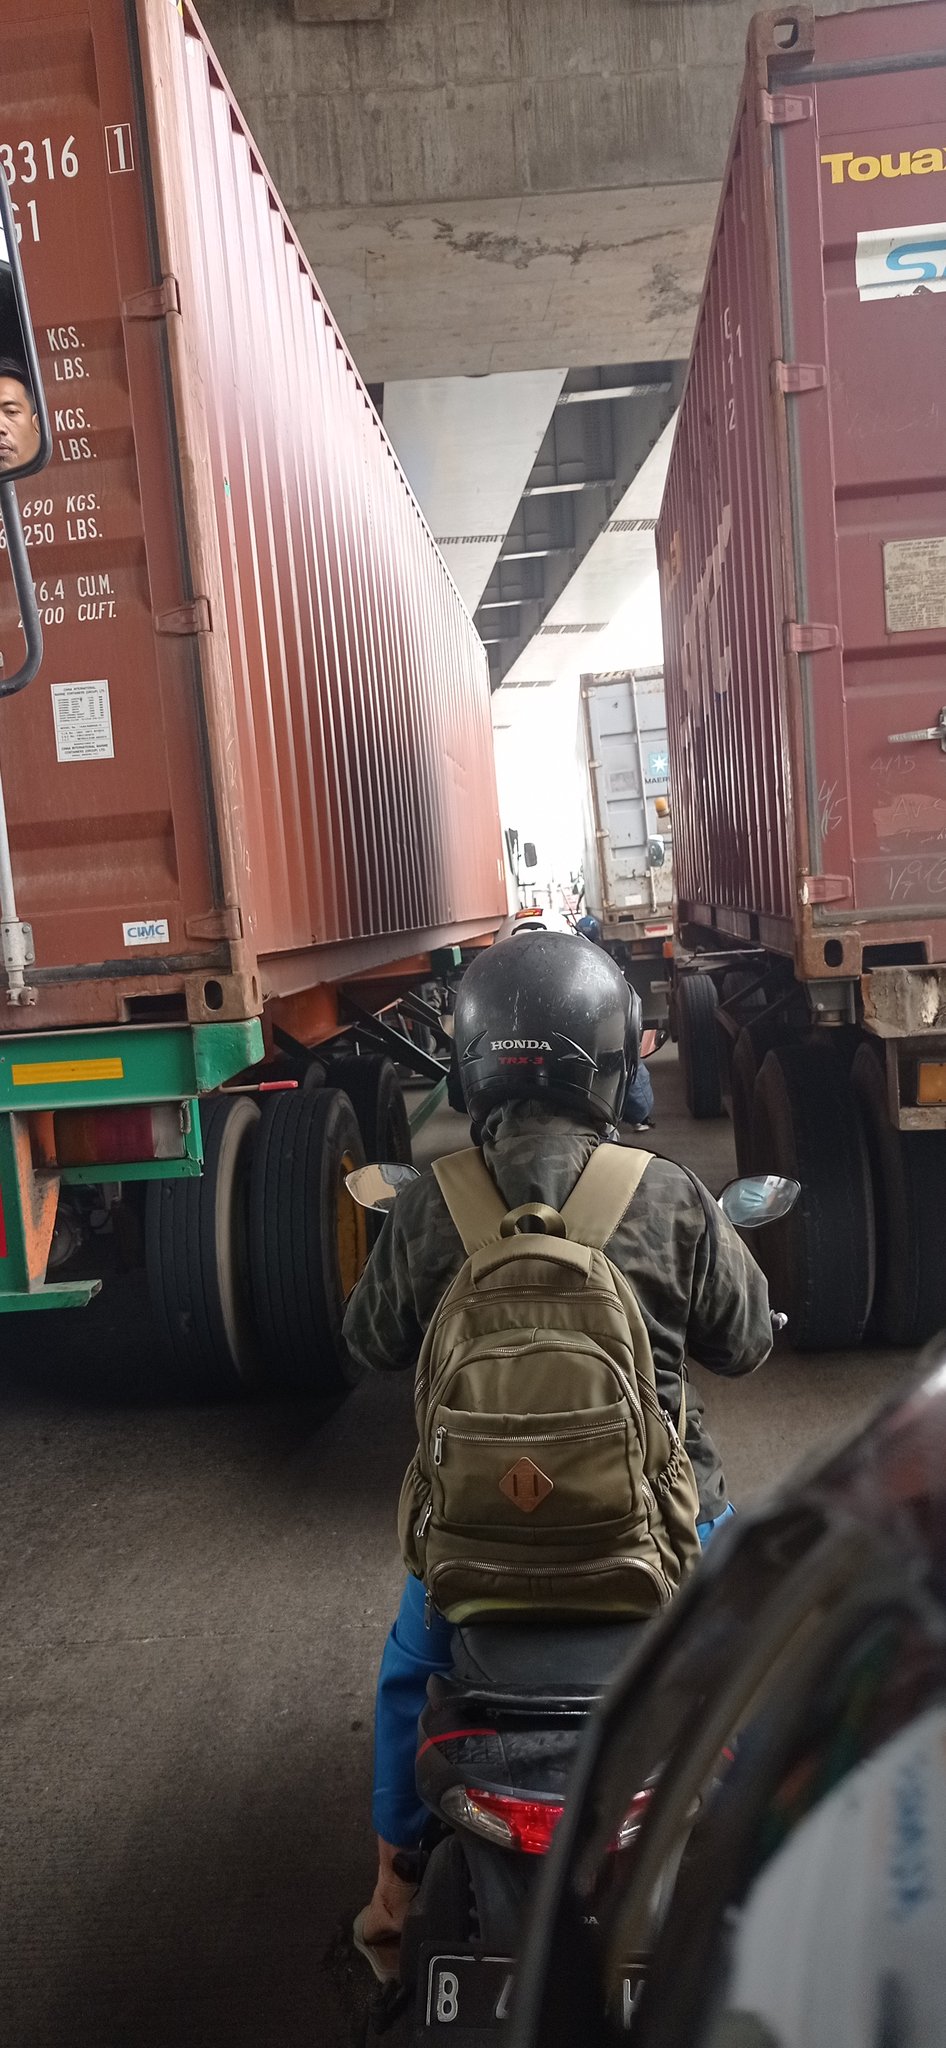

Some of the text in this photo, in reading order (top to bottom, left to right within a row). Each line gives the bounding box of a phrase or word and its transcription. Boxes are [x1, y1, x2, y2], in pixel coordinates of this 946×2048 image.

[113, 127, 126, 170] 1
[821, 148, 946, 184] Toua
[47, 326, 85, 351] KGS.
[54, 357, 90, 381] LBS.
[55, 408, 91, 431] KGS.
[59, 437, 97, 462] LBS.
[66, 494, 101, 513] KGS.
[66, 518, 103, 541] LBS.
[77, 574, 114, 597] CU.M.
[77, 601, 117, 621] CU.FT.
[127, 924, 166, 938] CIMC
[490, 1039, 553, 1051] HONDA
[437, 1971, 459, 2023] B
